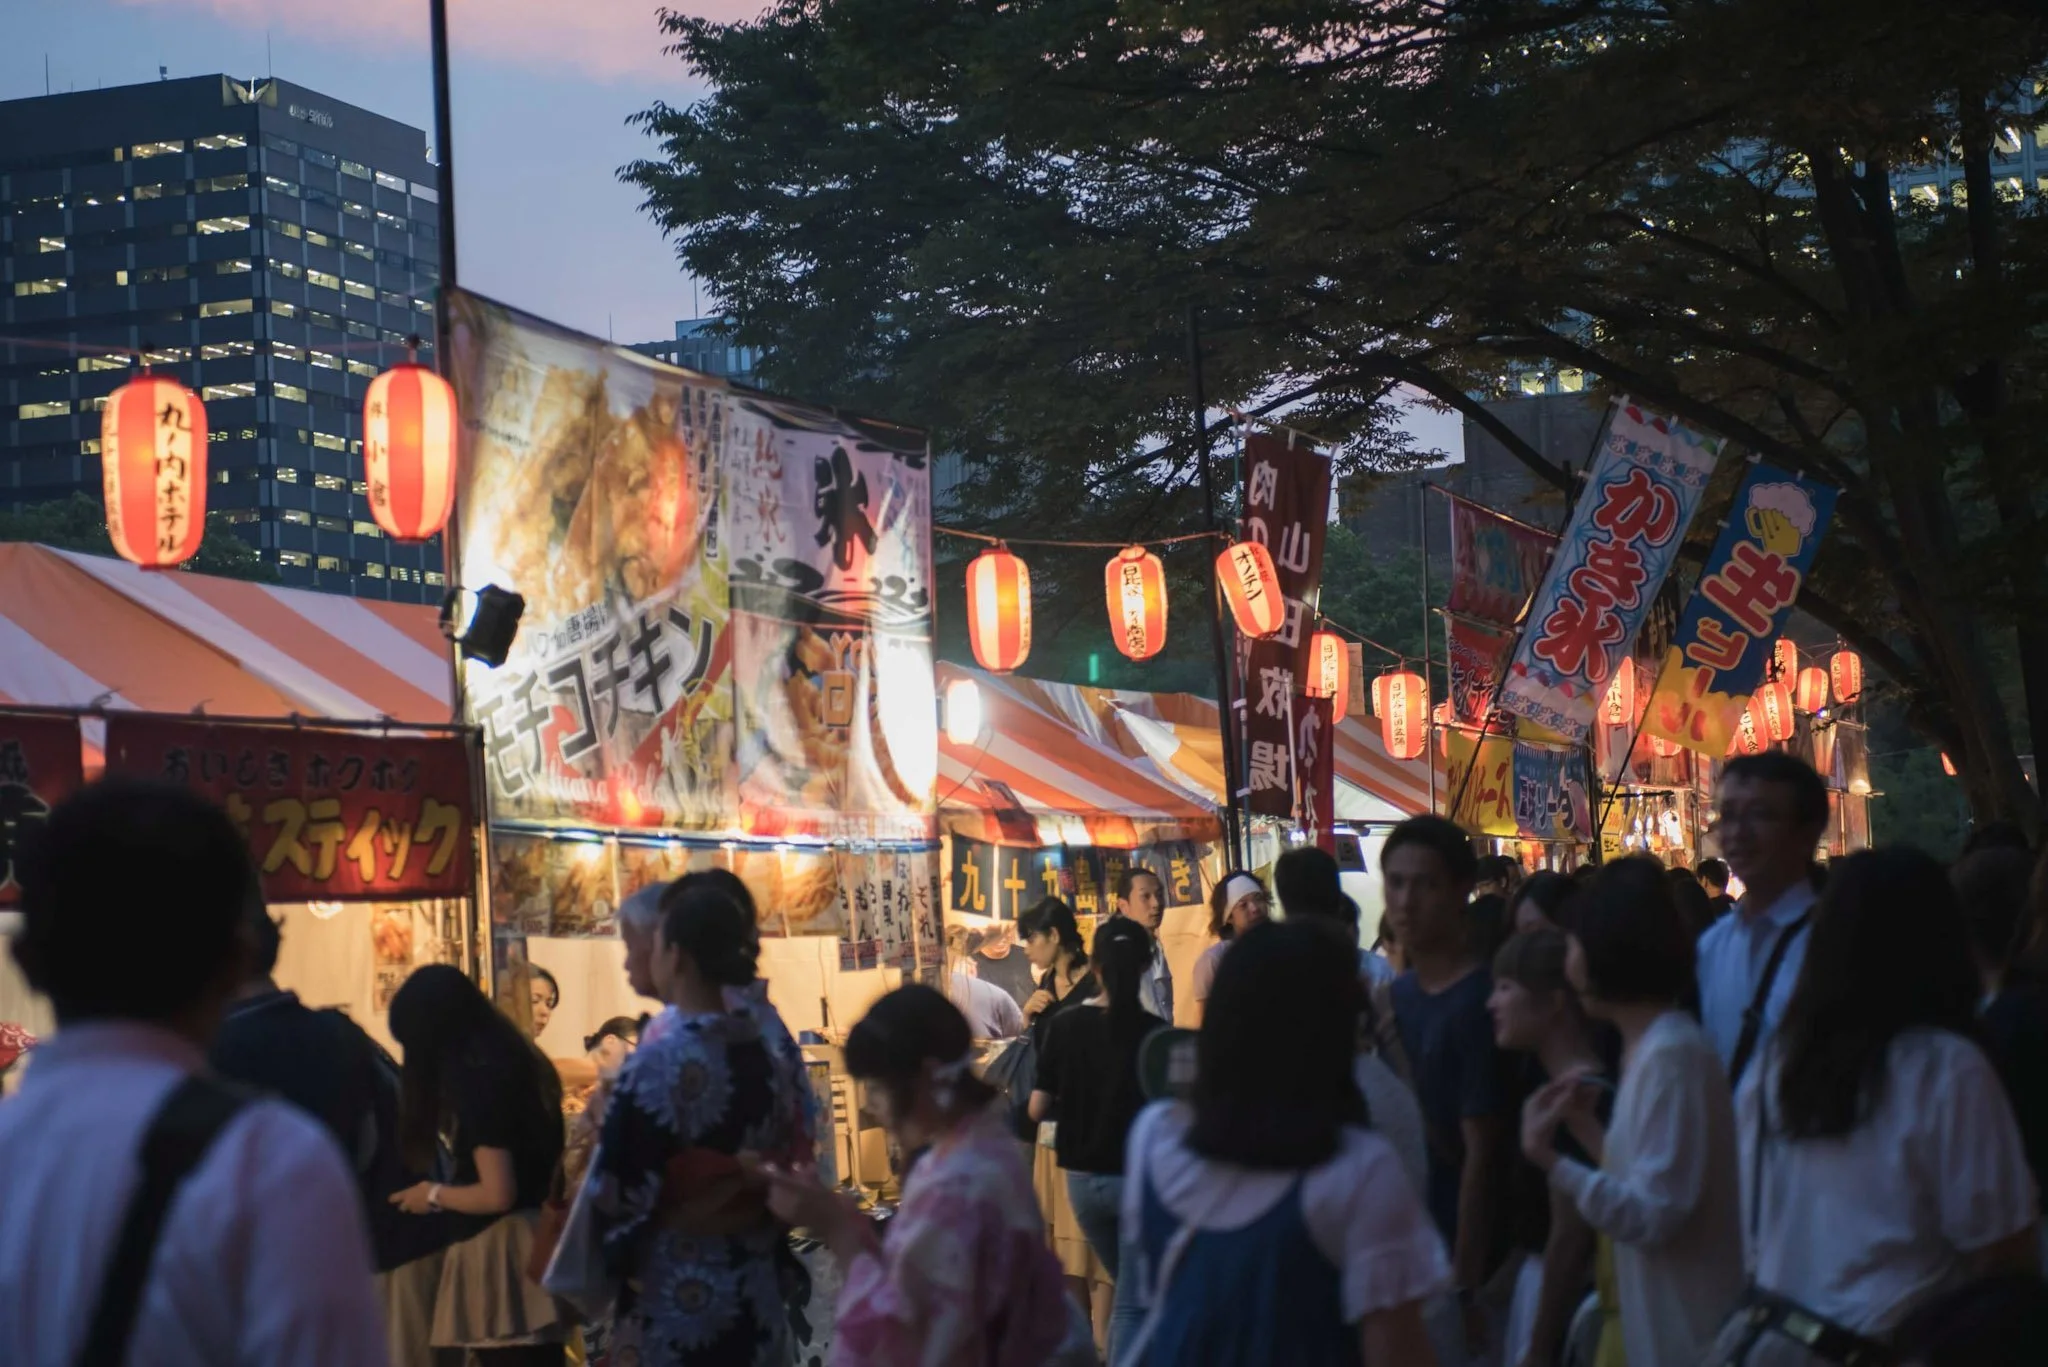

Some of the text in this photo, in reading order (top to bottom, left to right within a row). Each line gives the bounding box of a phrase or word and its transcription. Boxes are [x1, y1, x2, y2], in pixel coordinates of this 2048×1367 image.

[154, 402, 193, 552] 丸ノ内ホテル
[1533, 466, 1680, 684] かき氷
[474, 606, 713, 798] モチコチキン
